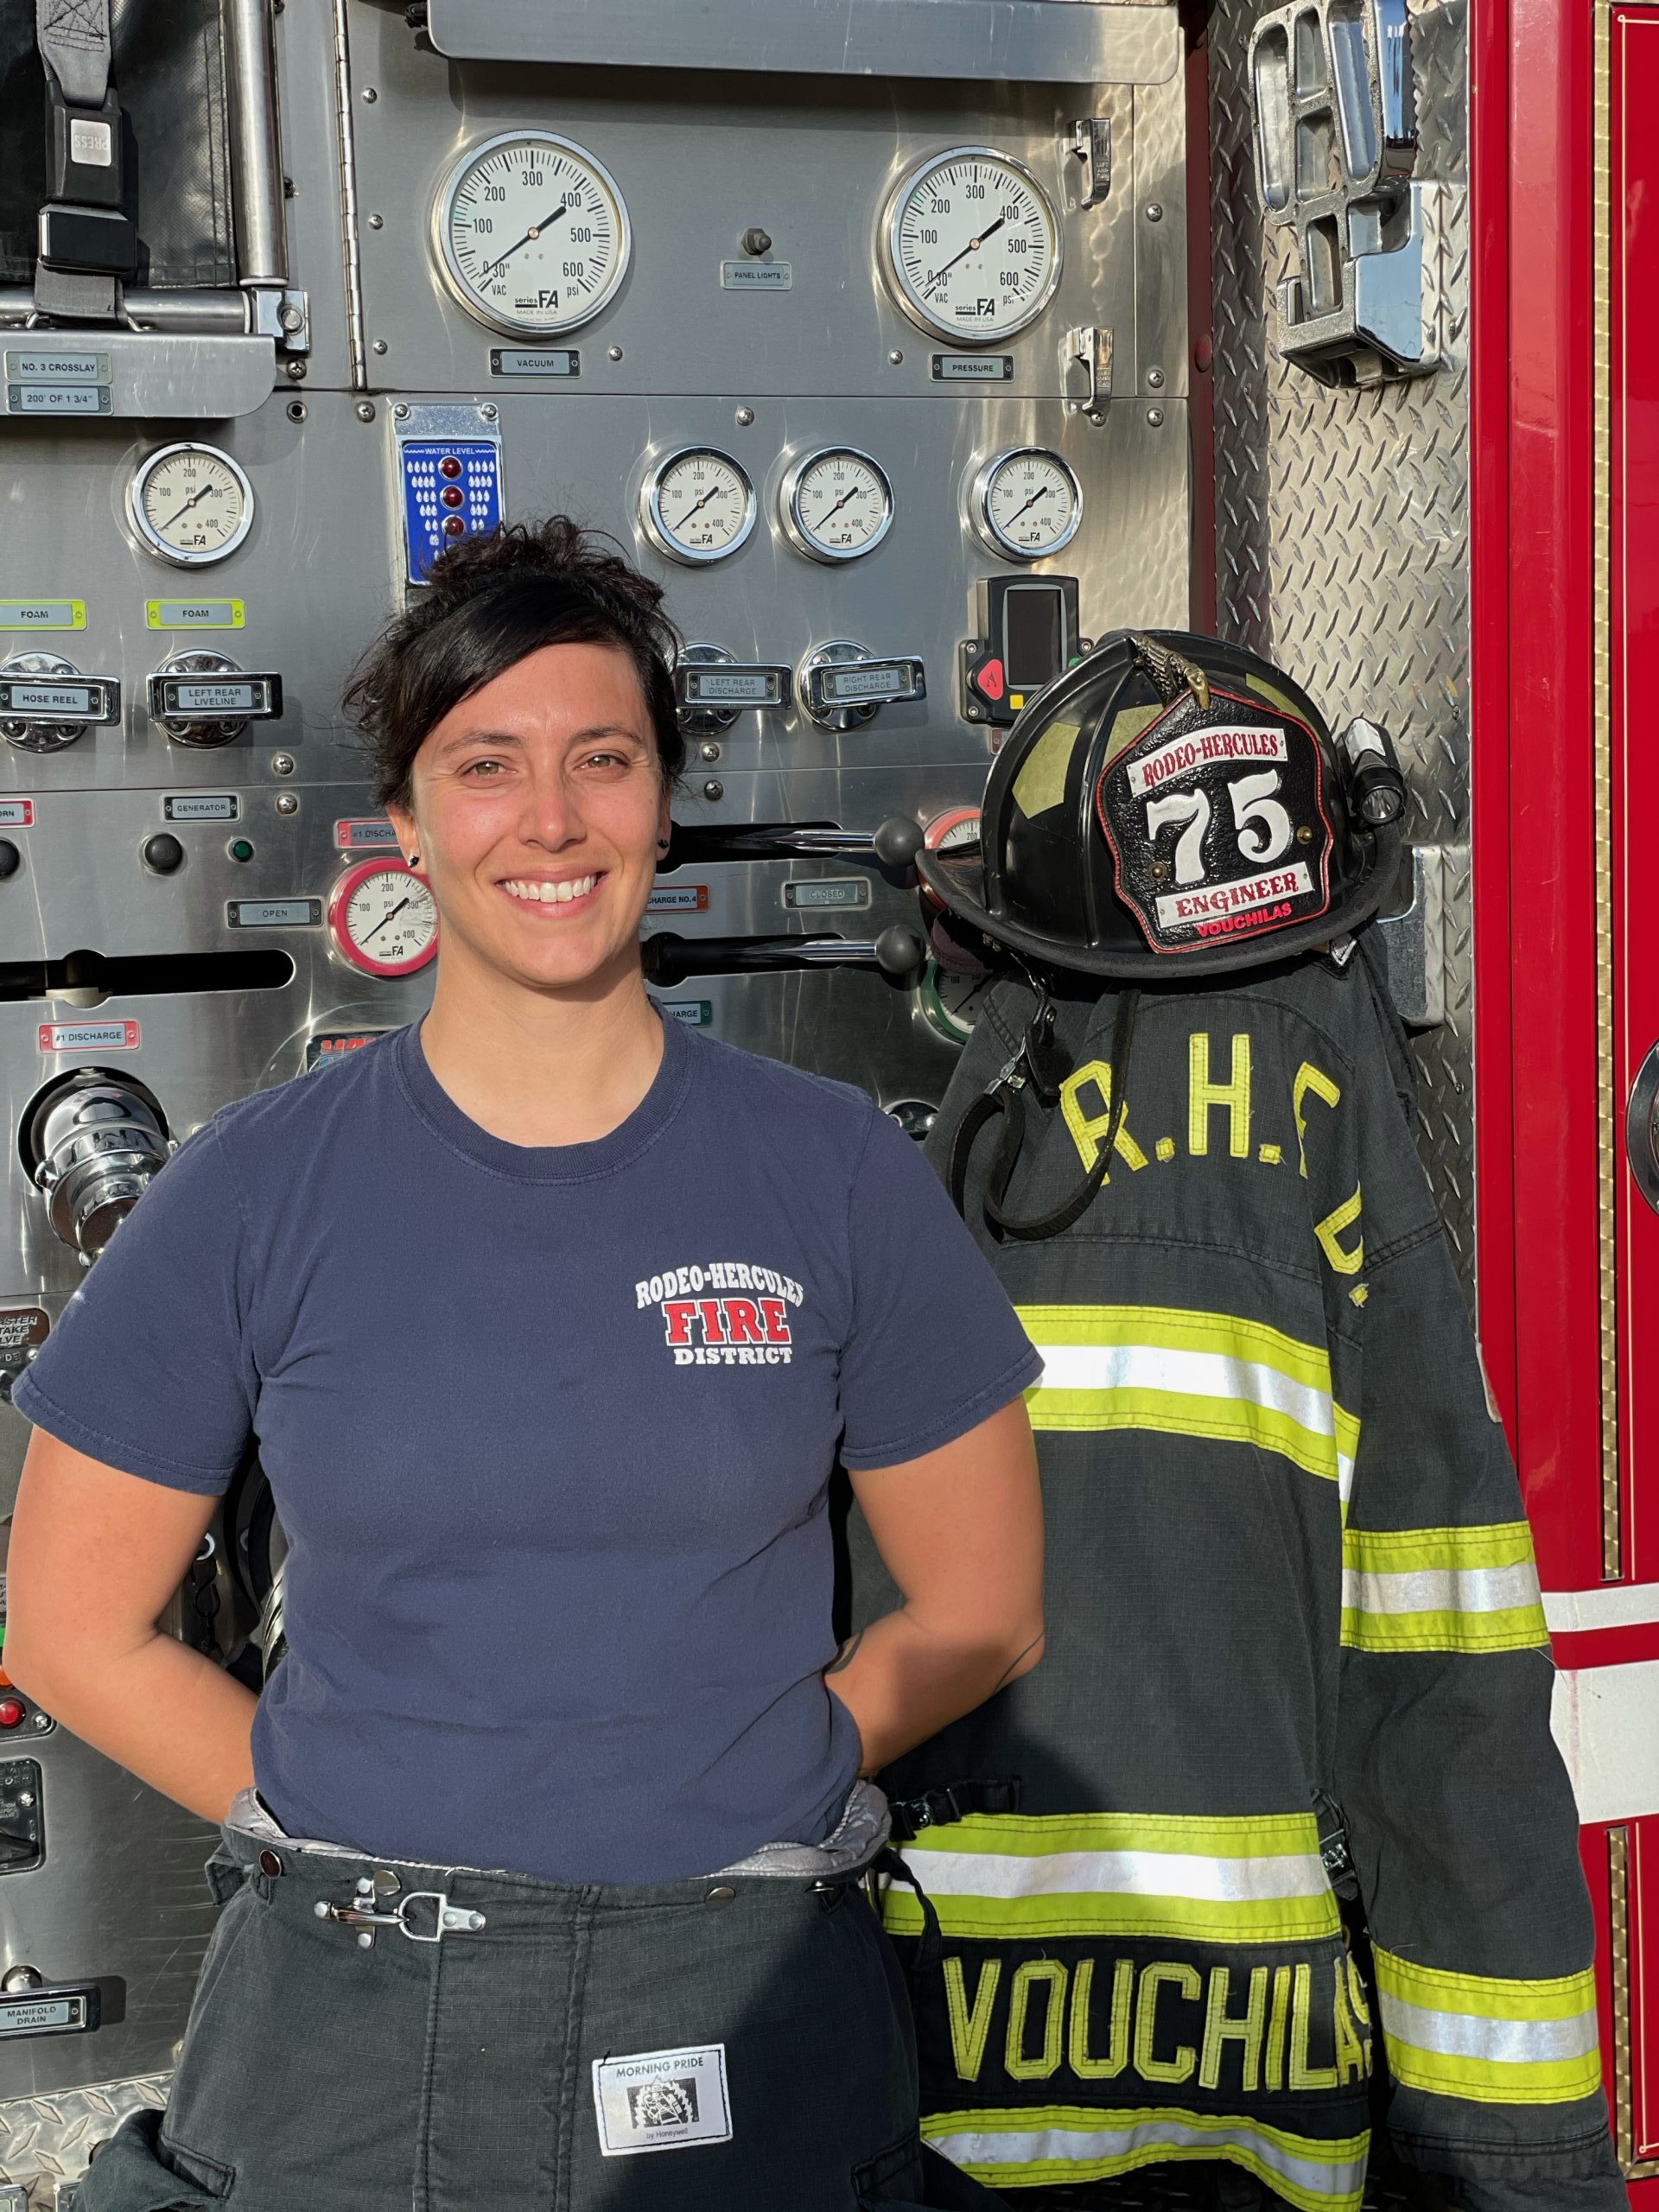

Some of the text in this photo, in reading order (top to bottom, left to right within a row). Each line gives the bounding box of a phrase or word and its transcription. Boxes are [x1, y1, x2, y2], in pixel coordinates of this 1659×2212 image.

[74, 135, 109, 150] PRESS
[522, 171, 543, 186] 300
[484, 187, 505, 201] 200
[966, 185, 985, 200] 300
[561, 193, 582, 207] 400
[931, 200, 950, 213] 200
[1000, 206, 1019, 219] 400
[474, 219, 493, 233] 100
[570, 228, 591, 242] 500
[920, 230, 938, 244] 100
[1008, 239, 1027, 253] 500
[563, 263, 583, 276] 600
[1000, 271, 1019, 286] 600
[492, 285, 506, 296] VAC
[567, 284, 579, 298] psi
[538, 290, 559, 308] FA
[935, 292, 948, 303] VAC
[1003, 292, 1014, 306] psi
[976, 298, 995, 315] FA
[22, 363, 38, 372] NO.
[48, 364, 95, 372] CROSSLAY
[183, 468, 196, 478] 200
[693, 472, 704, 480] 200
[833, 472, 844, 480] 200
[1023, 472, 1034, 480] 200
[159, 487, 171, 497] 100
[185, 486, 196, 495] psi
[210, 489, 223, 498] 300
[671, 490, 682, 499] 100
[695, 488, 704, 497] psi
[716, 491, 728, 499] 300
[812, 490, 823, 499] 100
[835, 488, 844, 497] psi
[855, 491, 867, 499] 300
[1025, 487, 1034, 496] psi
[1045, 490, 1056, 499] 300
[205, 519, 219, 528] 400
[712, 519, 724, 528] 400
[1039, 518, 1052, 526] 400
[194, 535, 206, 545] FA
[702, 534, 713, 543] FA
[841, 534, 852, 543] FA
[1030, 532, 1040, 542] FA
[710, 678, 755, 687] LEFT REAR
[843, 672, 892, 684] RIGHT REAR
[709, 686, 757, 696] DISCHARGE
[845, 681, 892, 692] DISCHARGE
[188, 688, 241, 697] LEFT REAR
[22, 695, 78, 705] HOSE REEL
[194, 697, 237, 706] LIVELINE
[1141, 733, 1278, 788] RODEO-HERCULES
[1146, 769, 1290, 885] 75
[967, 832, 978, 841] 200
[381, 883, 394, 893] 200
[810, 890, 844, 899] CLOSED
[1175, 872, 1299, 918] ENGINEER
[359, 903, 371, 912] 100
[384, 899, 394, 908] psi
[407, 901, 419, 910] 300
[1196, 902, 1293, 938] VOUCHILAS
[403, 930, 415, 938] 400
[392, 946, 404, 957] FA
[68, 1032, 122, 1041] DISCHARGE
[635, 1262, 804, 1309] RODEO-HERCULES
[0, 1316, 37, 1325] STER
[661, 1297, 792, 1346] FIRE
[673, 1348, 793, 1366] DISTRICT
[7, 2006, 56, 2018] MANIFOLD
[17, 2016, 47, 2024] DRAIN
[616, 2056, 704, 2078] MORNING PRIDE
[646, 2128, 689, 2140] by Honeywell
